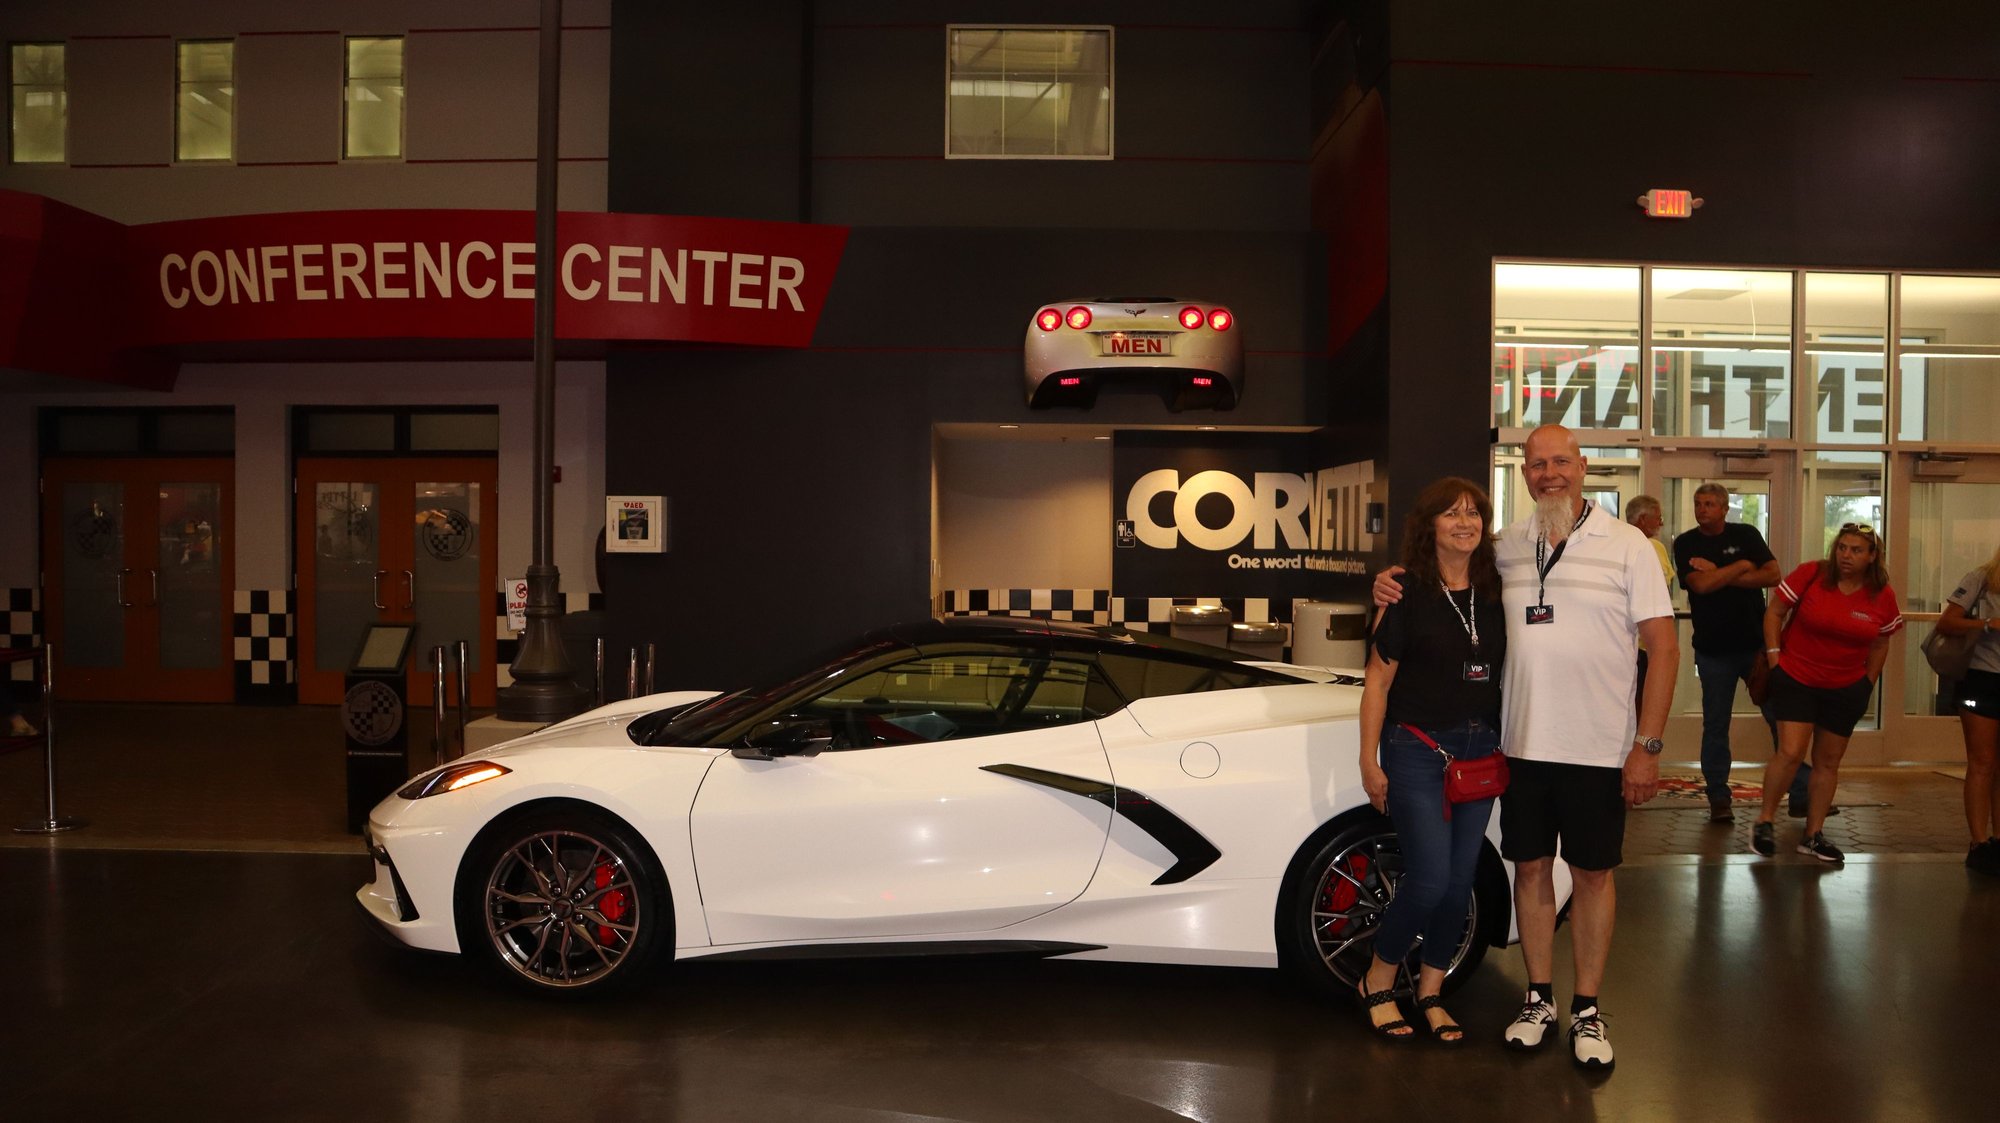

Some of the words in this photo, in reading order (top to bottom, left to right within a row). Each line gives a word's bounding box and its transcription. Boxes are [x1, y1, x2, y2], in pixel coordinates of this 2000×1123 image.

[1656, 191, 1687, 215] EXIT
[160, 241, 536, 308] CONFERENCE
[561, 243, 805, 312] CENTER
[1111, 339, 1162, 353] MEN
[1126, 459, 1375, 552] CORVETTE
[1227, 553, 1261, 569] One
[1263, 554, 1302, 569] word
[1471, 664, 1483, 672] VIP
